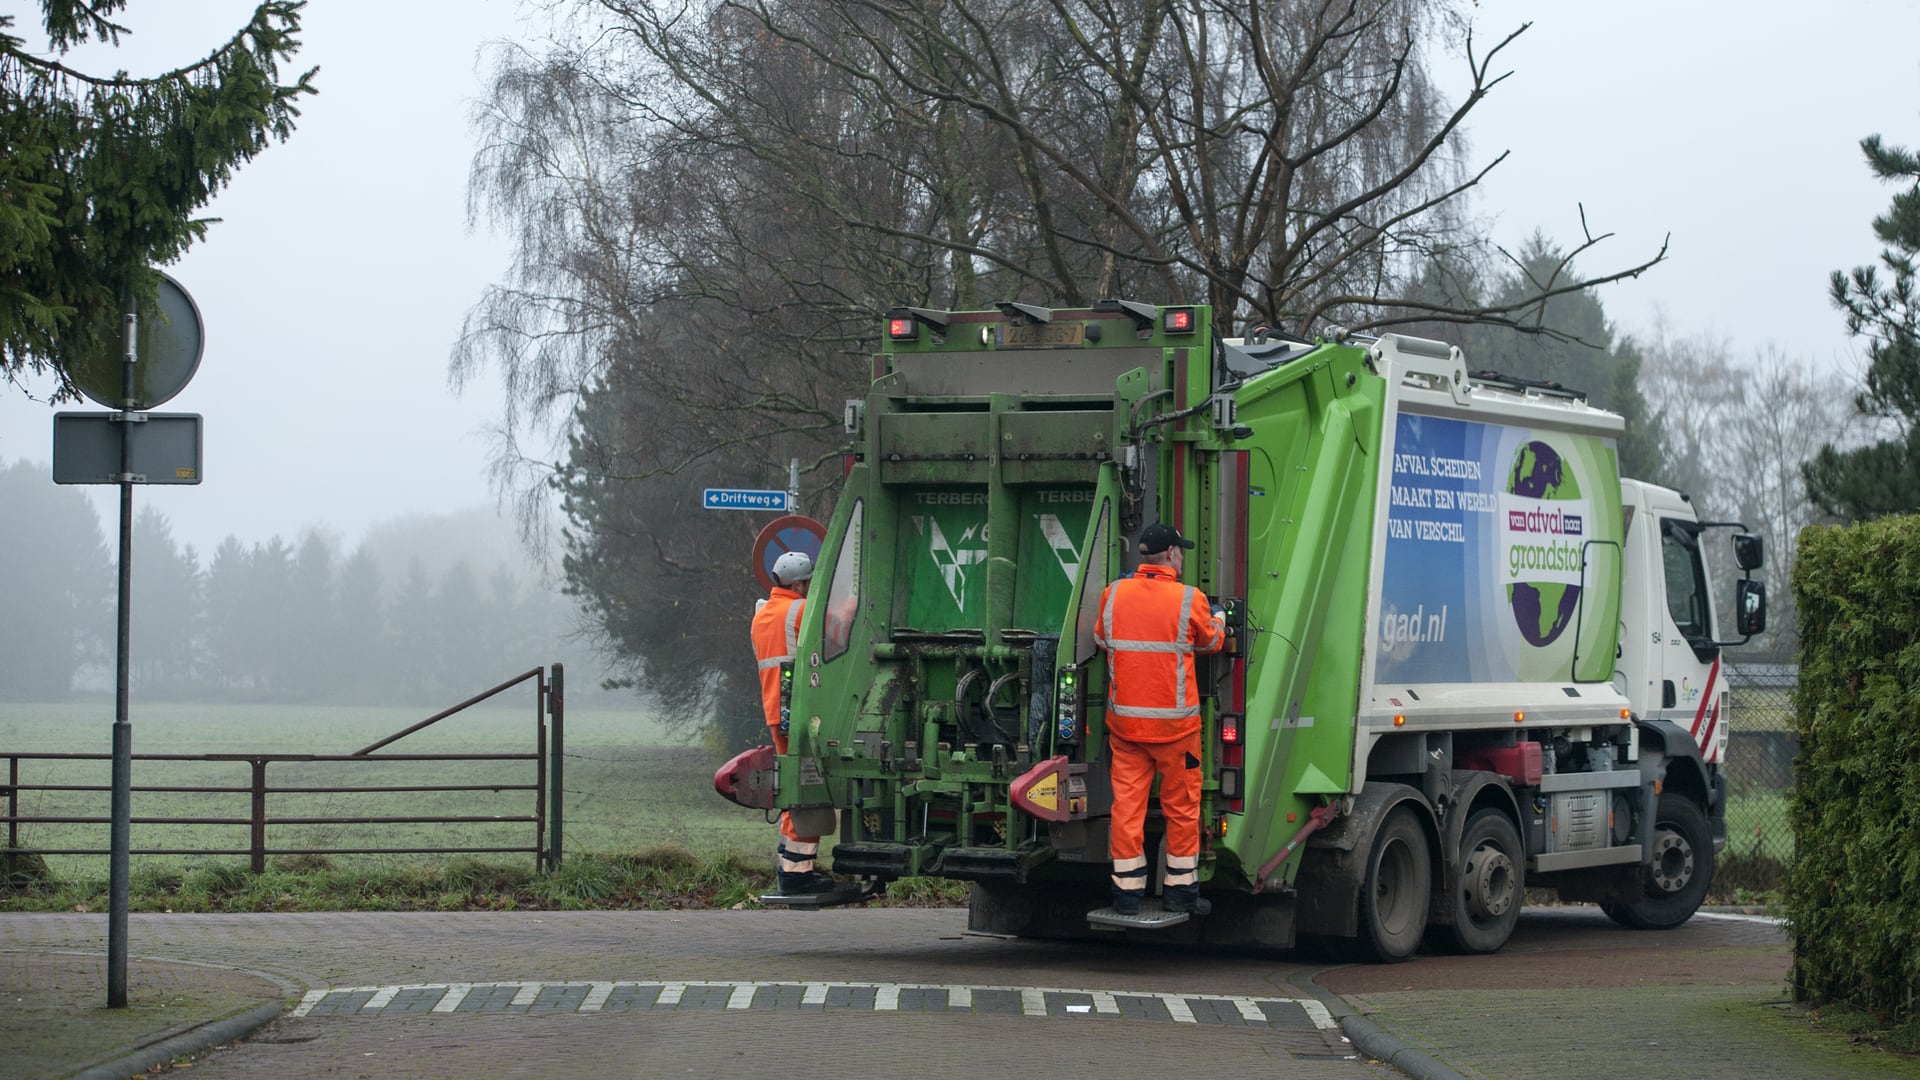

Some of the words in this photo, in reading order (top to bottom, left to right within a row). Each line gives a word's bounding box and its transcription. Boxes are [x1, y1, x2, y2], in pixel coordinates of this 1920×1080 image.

[1395, 454, 1429, 475] AFVAL
[1430, 457, 1481, 480] SCHEIDEN
[721, 493, 770, 507] Driftweg
[1036, 490, 1096, 503] TERBE
[1392, 486, 1432, 508] MAAKT
[1434, 489, 1454, 510] EEN
[1457, 491, 1497, 512] WERELD
[1389, 519, 1412, 539] VAN
[1415, 520, 1465, 542] VERSCHIL
[1510, 515, 1525, 528] van
[1527, 506, 1563, 534] afval
[1564, 518, 1581, 532] naar
[1510, 539, 1583, 577] grondstof
[1382, 604, 1447, 652] gad.nl
